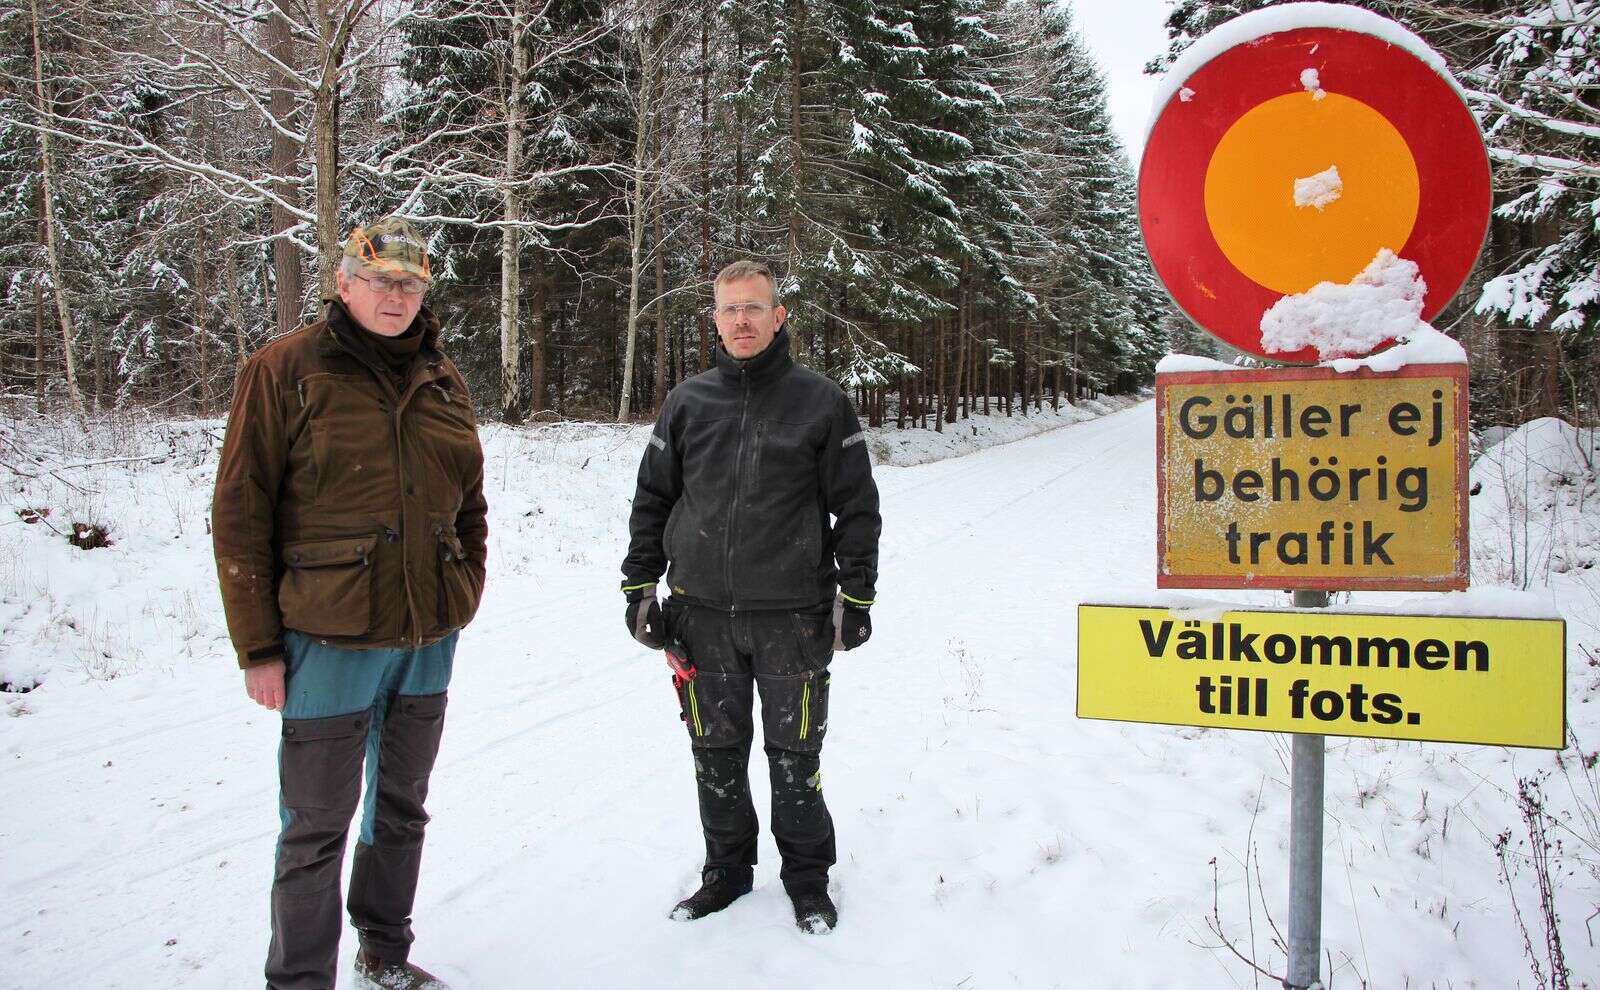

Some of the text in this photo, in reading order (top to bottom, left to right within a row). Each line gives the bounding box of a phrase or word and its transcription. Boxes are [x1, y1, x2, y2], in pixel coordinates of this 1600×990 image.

[1179, 389, 1444, 447] Gäller ej
[1194, 455, 1429, 512] behörig
[1225, 521, 1395, 566] trafik
[1139, 619, 1490, 672] Välkommen
[1196, 675, 1421, 725] till fots.
